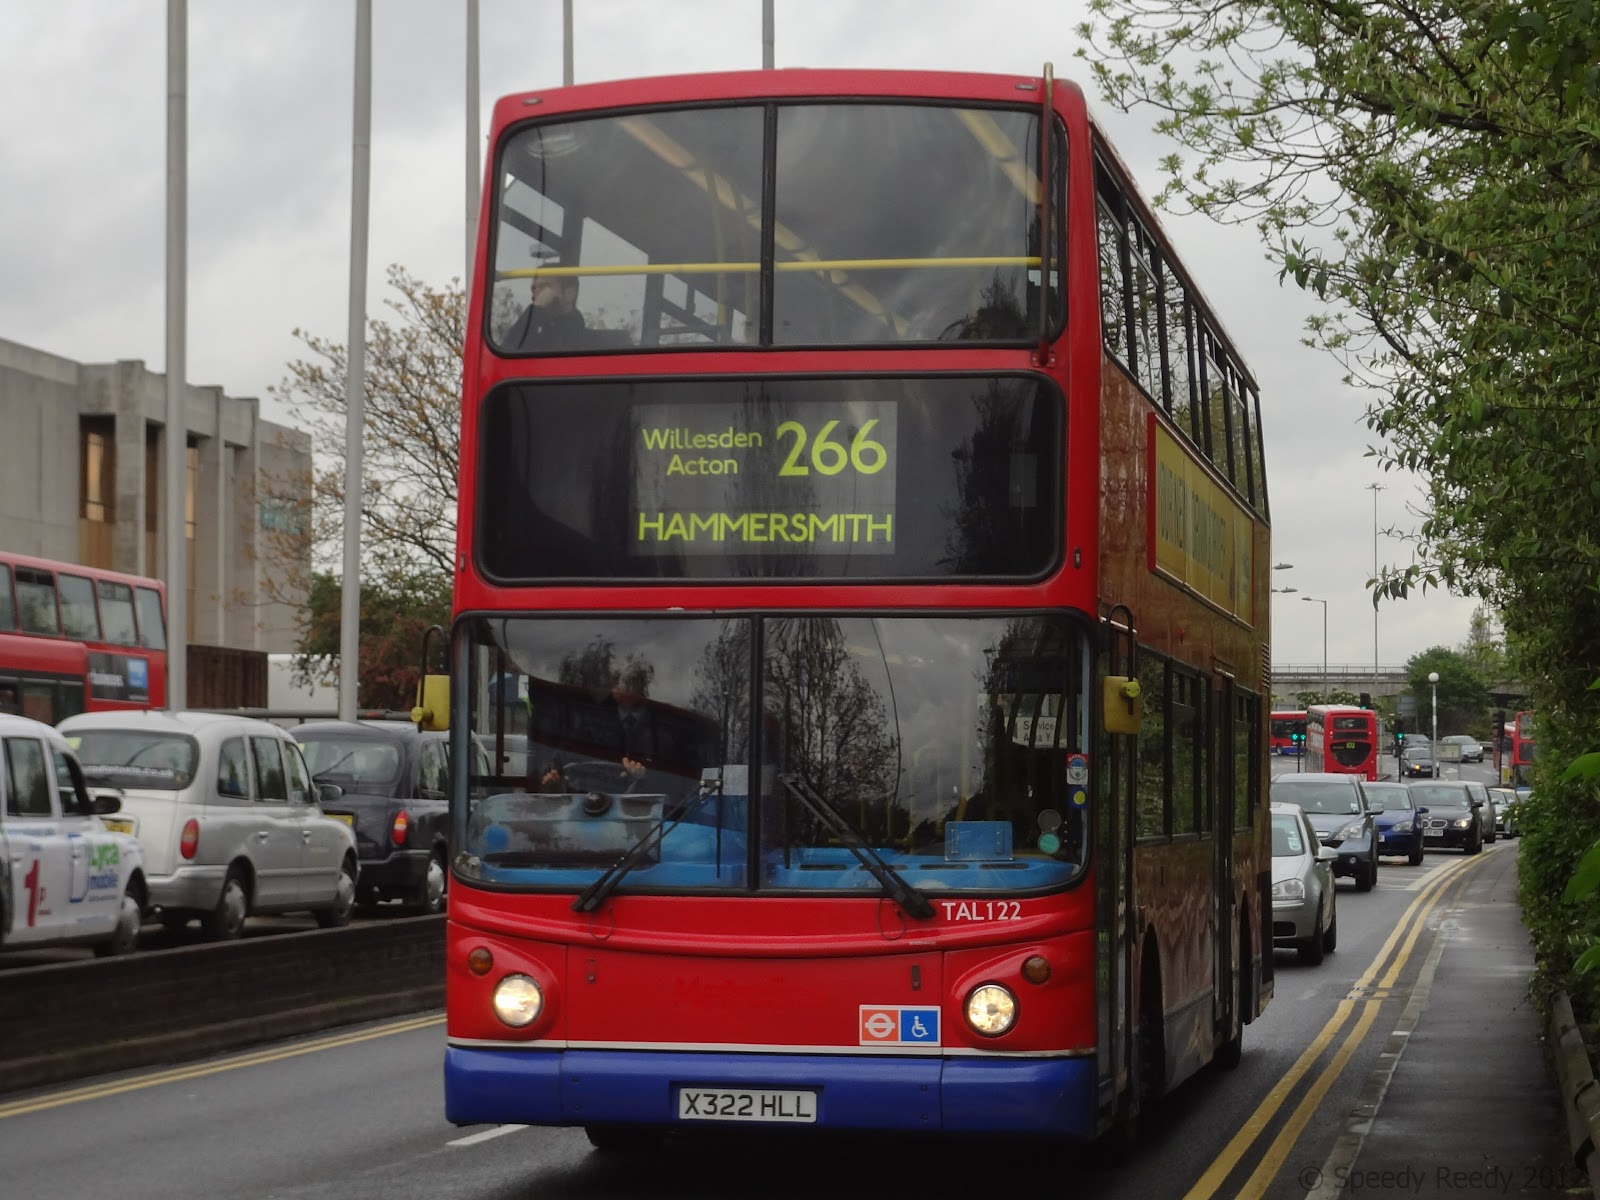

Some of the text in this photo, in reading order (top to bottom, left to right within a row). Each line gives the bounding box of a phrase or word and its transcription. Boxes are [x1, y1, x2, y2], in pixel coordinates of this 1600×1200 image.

[642, 419, 887, 476] Willesden 266
[666, 454, 738, 476] Acton
[638, 512, 892, 542] HAMMERSMITH
[941, 902, 1021, 921] TAL122
[684, 1093, 811, 1118] X322 HLL
